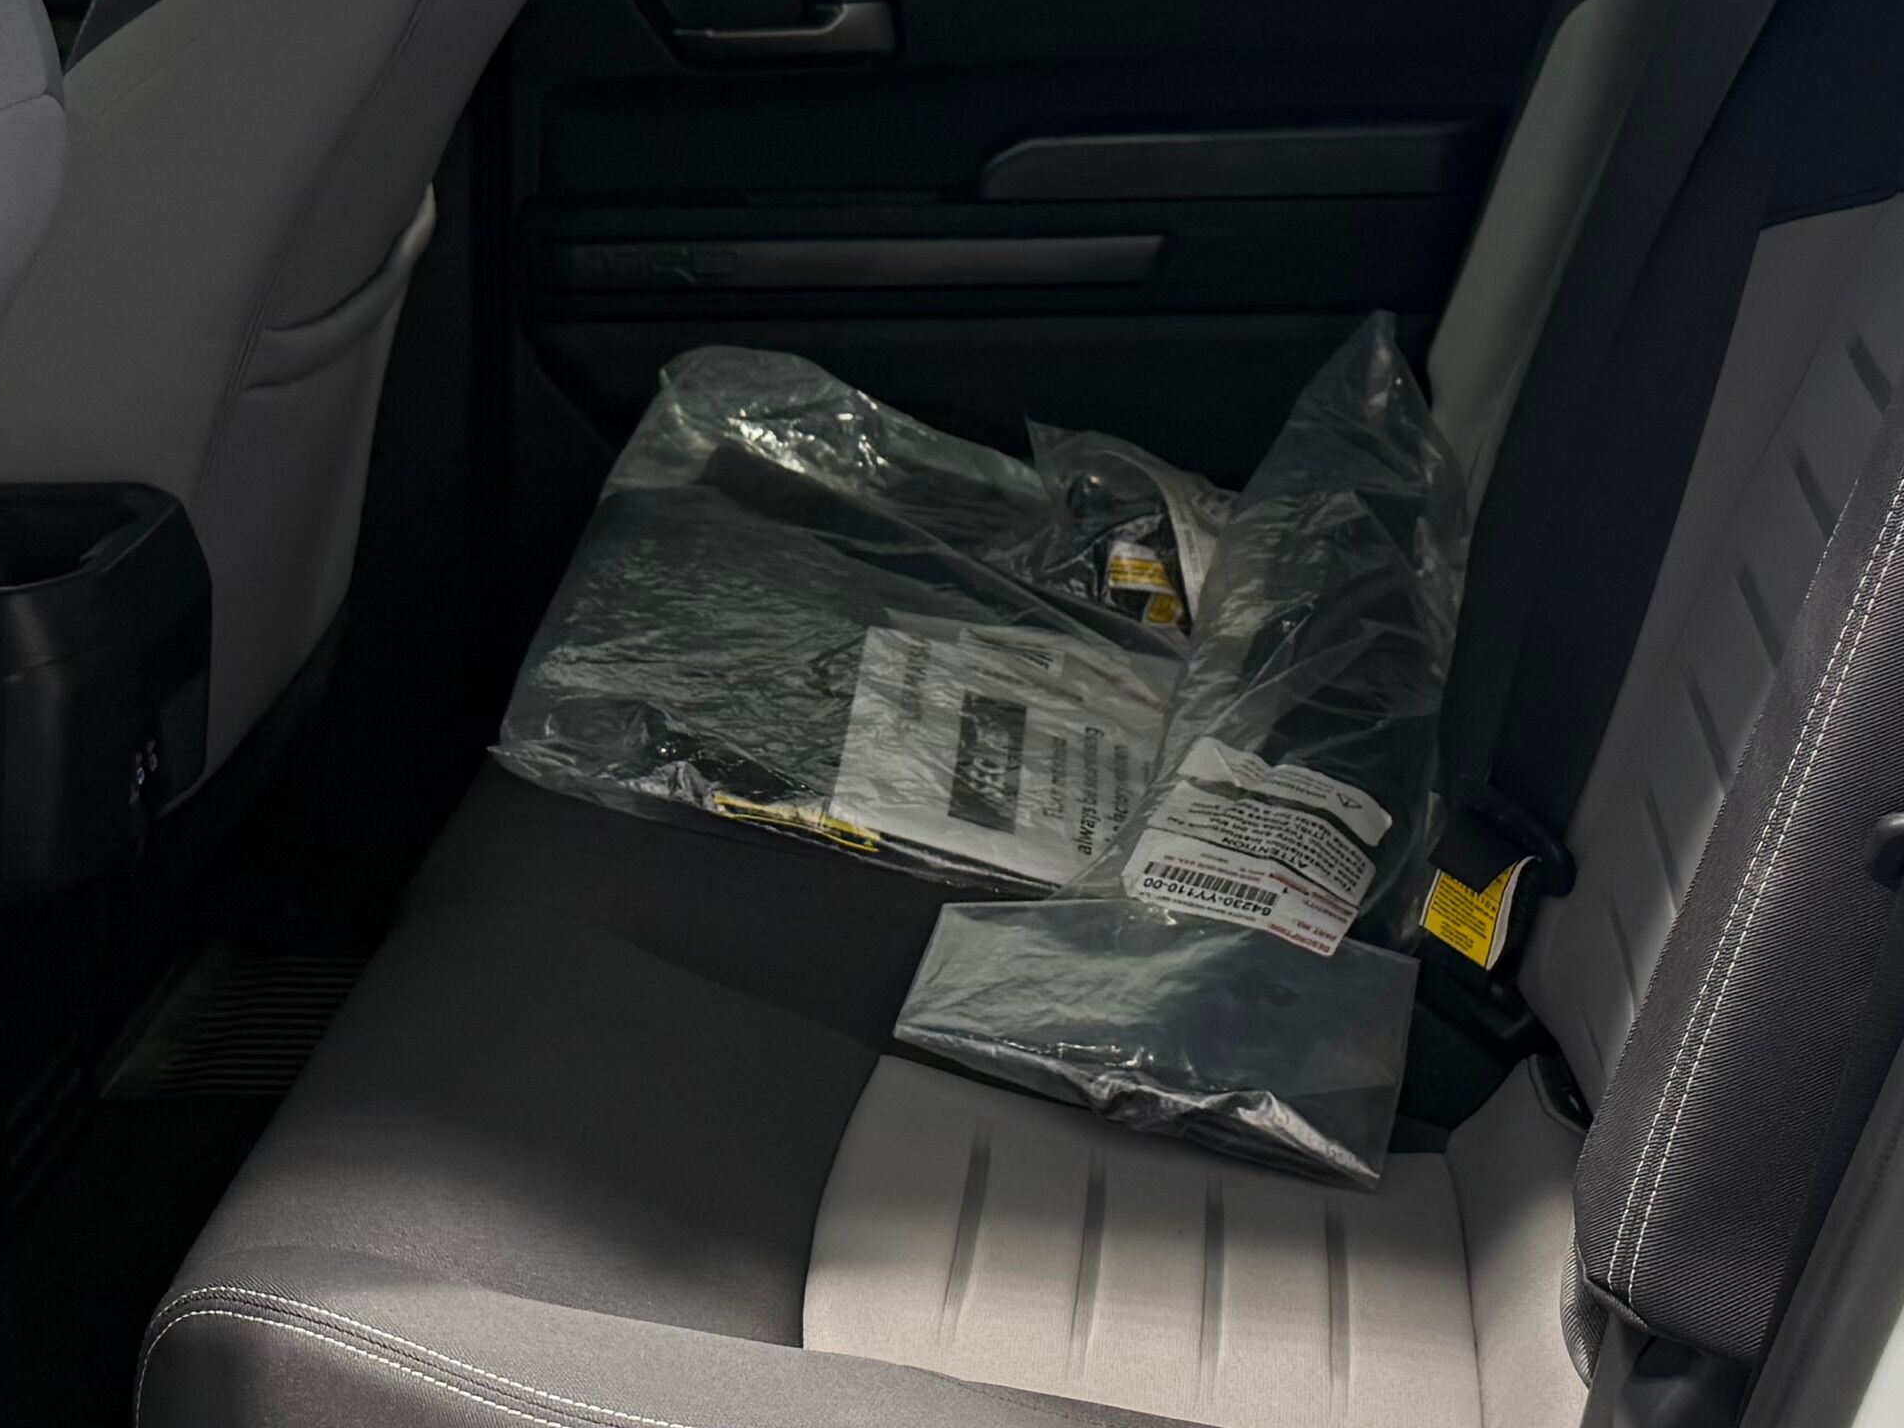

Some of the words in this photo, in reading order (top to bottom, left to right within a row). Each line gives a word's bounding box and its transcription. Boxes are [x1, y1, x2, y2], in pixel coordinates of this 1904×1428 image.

[1072, 806, 1101, 854] always
[1294, 815, 1331, 836] dealer
[1222, 837, 1308, 868] ATTENTION
[1275, 832, 1334, 869] accessory
